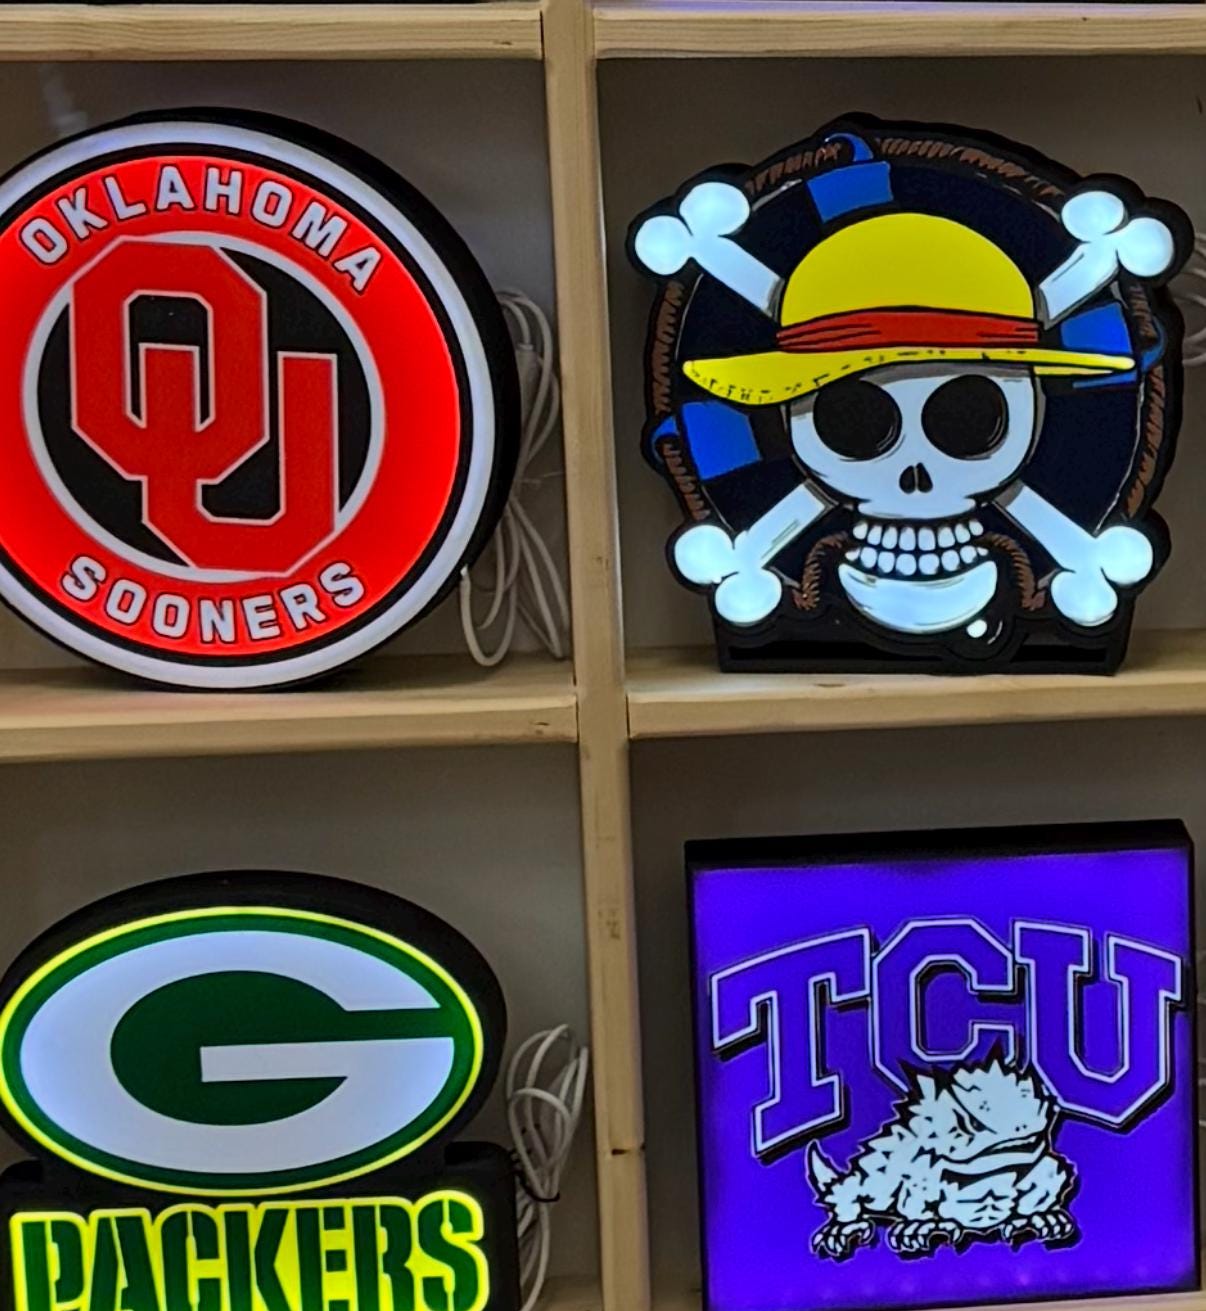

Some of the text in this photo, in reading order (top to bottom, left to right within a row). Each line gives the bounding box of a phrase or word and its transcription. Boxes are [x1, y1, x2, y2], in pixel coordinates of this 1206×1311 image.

[19, 164, 383, 294] OKLAHOMA
[60, 555, 366, 644] SOONERS
[711, 917, 1184, 1158] TCU
